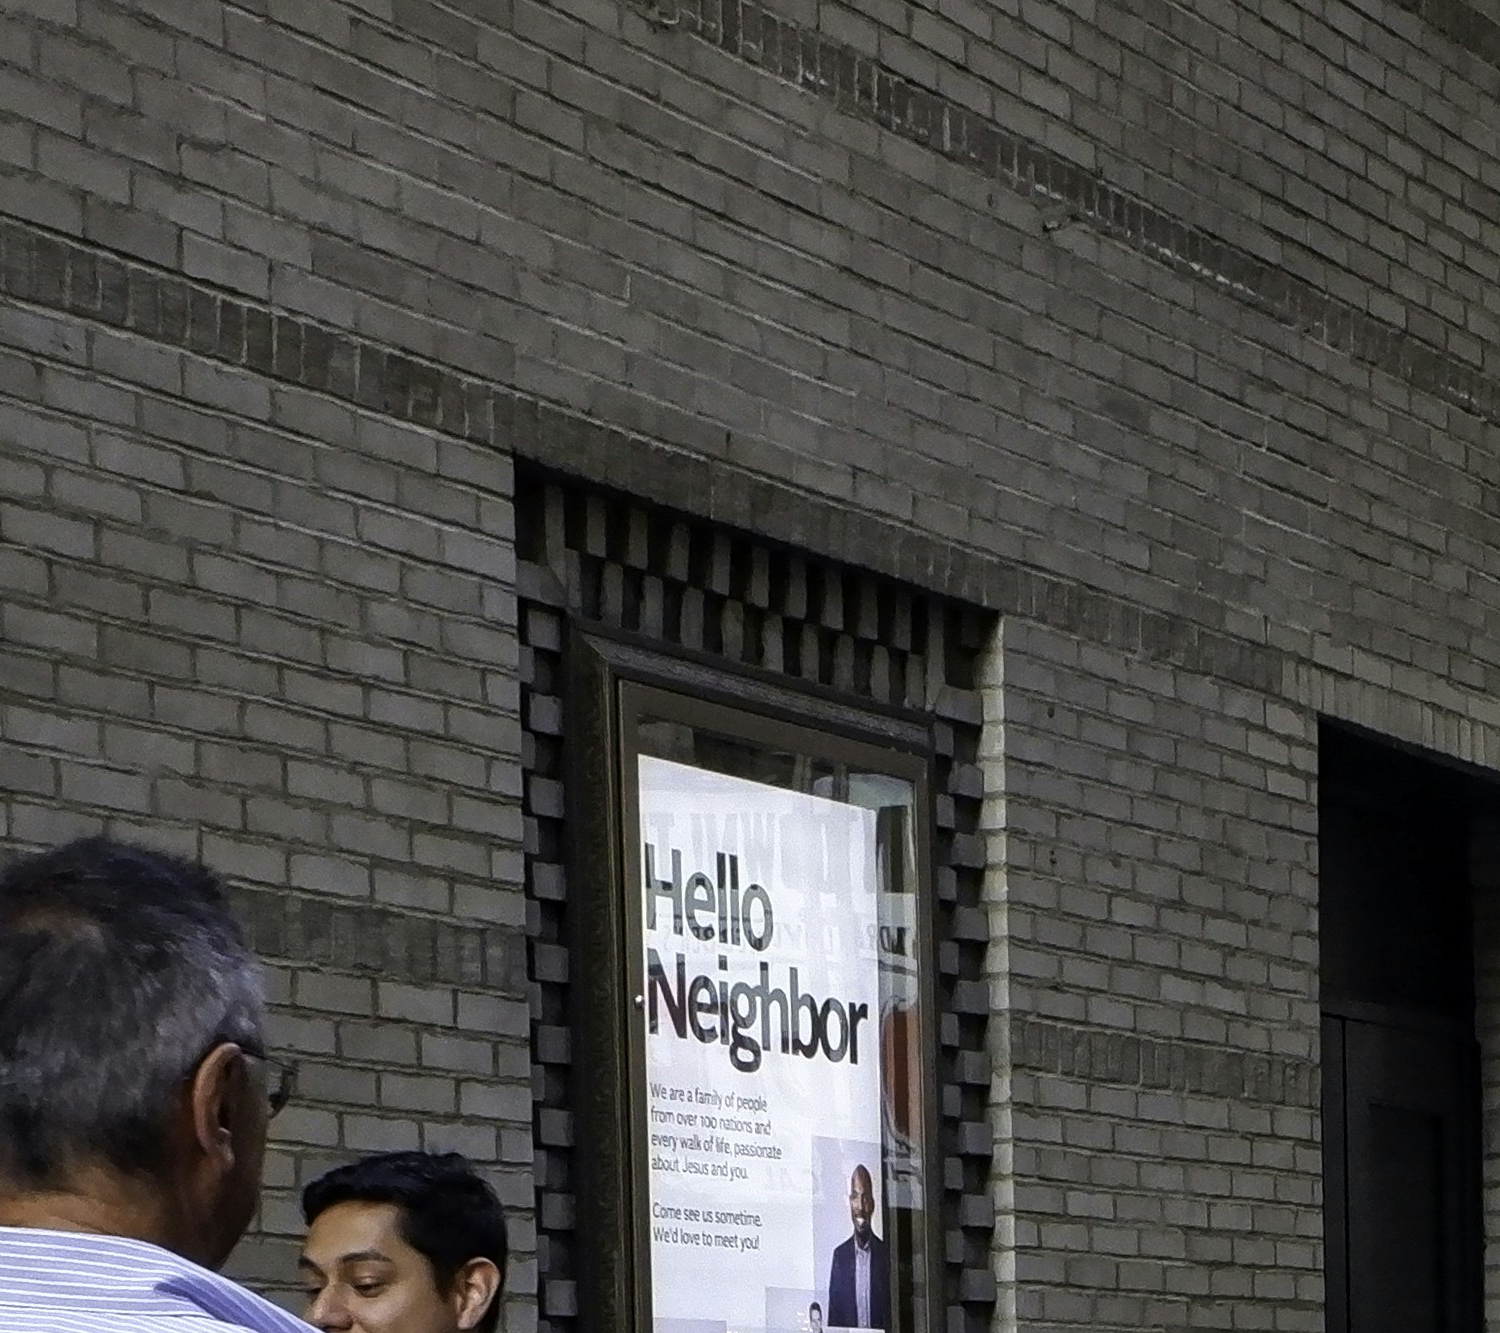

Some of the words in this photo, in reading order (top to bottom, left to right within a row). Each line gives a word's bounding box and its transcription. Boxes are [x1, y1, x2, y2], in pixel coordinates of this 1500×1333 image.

[645, 842, 773, 951] Hello
[647, 947, 868, 1073] Neighbor
[650, 1082, 667, 1101] We
[669, 1088, 685, 1103] are
[687, 1090, 694, 1103] a
[695, 1087, 722, 1111] family
[724, 1091, 736, 1109] of
[736, 1093, 768, 1113] people
[650, 1106, 675, 1125] from
[676, 1112, 699, 1127] over
[700, 1113, 718, 1130] 100
[719, 1116, 753, 1135] nations
[754, 1118, 771, 1136] and
[651, 1135, 678, 1152] every
[679, 1133, 702, 1152] walk
[703, 1134, 715, 1153] of
[733, 1139, 782, 1160] passionate
[651, 1155, 679, 1173] about
[681, 1159, 709, 1176] Jesus
[711, 1159, 728, 1177] and
[652, 1201, 682, 1221] Come
[683, 1206, 701, 1222] see
[702, 1208, 713, 1223] us
[653, 1225, 680, 1244] We'd
[680, 1227, 700, 1246] love
[701, 1230, 713, 1247] to
[714, 1231, 738, 1249] meet
[739, 1234, 760, 1253] you!
